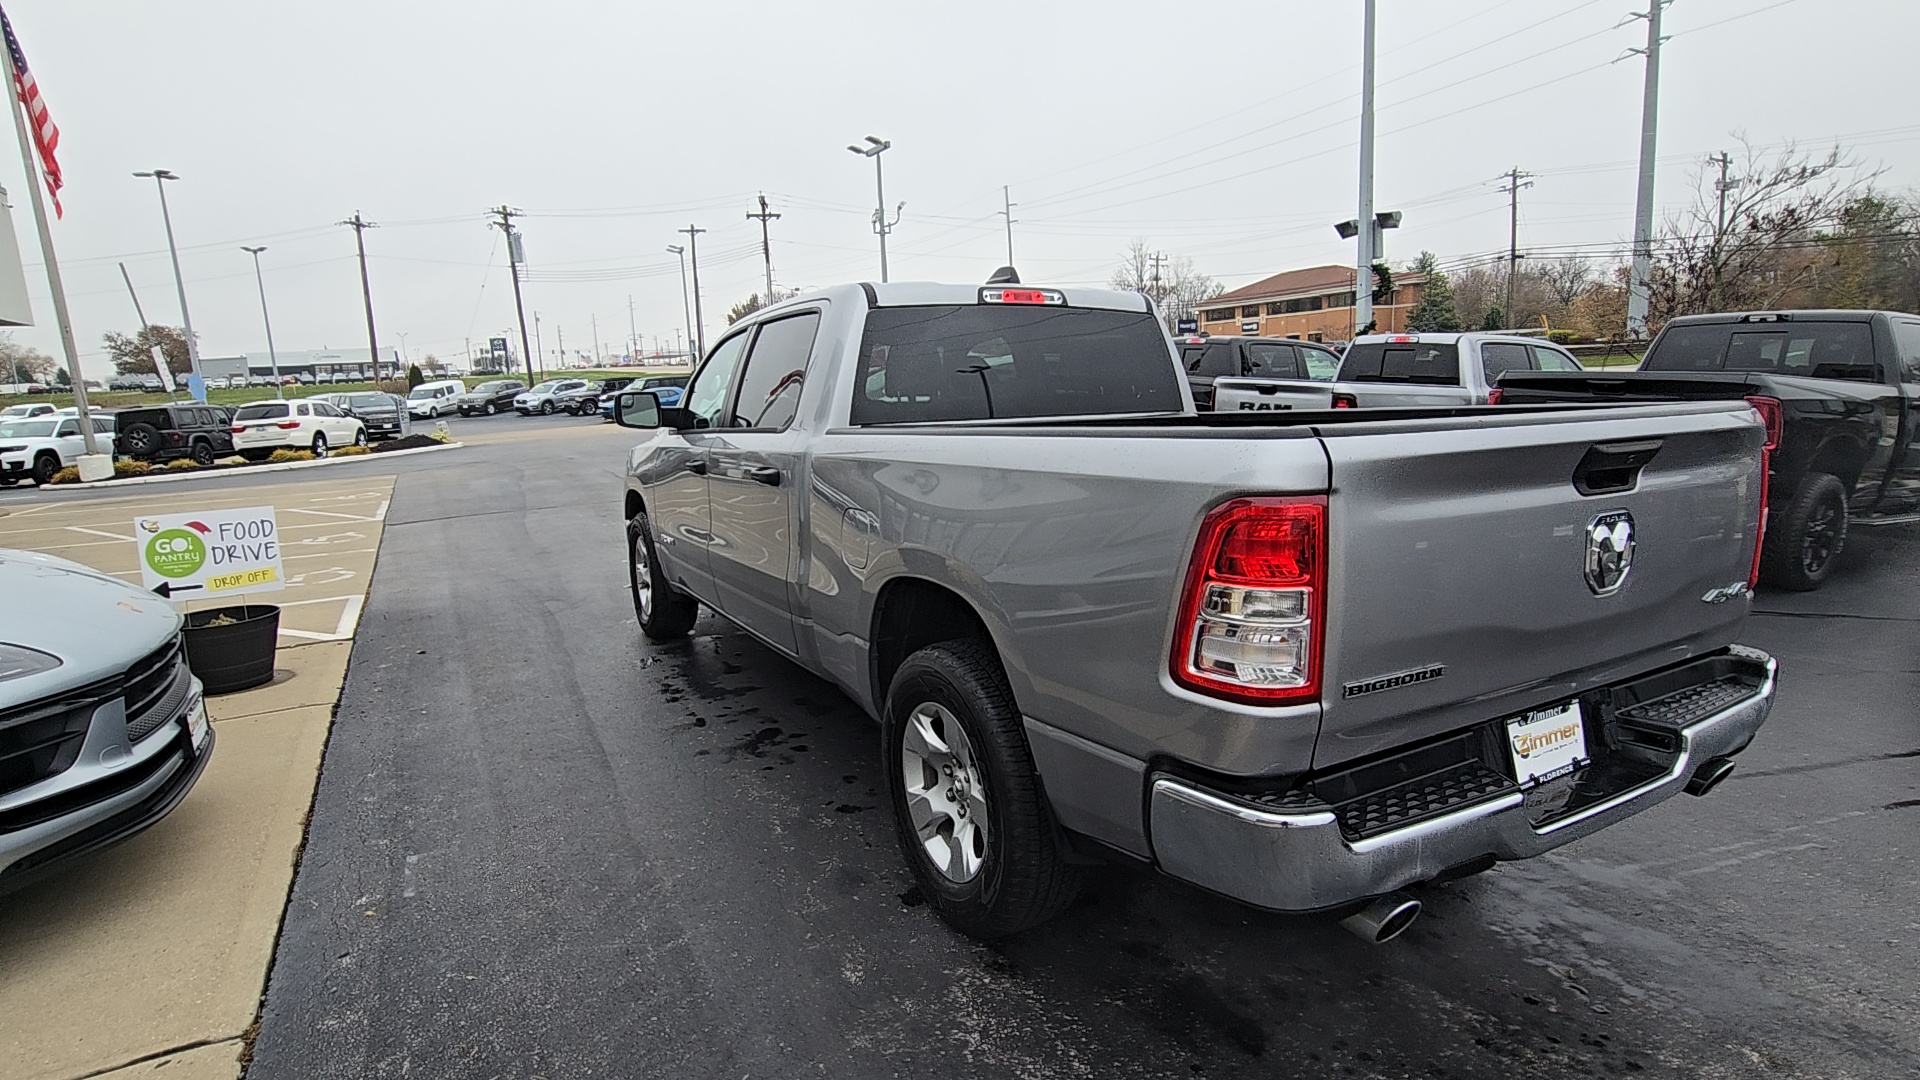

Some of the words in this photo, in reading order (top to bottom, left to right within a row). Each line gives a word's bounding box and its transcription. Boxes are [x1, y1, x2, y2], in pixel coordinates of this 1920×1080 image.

[1239, 402, 1292, 411] RAM
[219, 519, 274, 542] FOOD
[155, 537, 194, 554] GO!
[211, 541, 278, 565] DRIVE
[154, 551, 200, 563] PANTRY
[213, 574, 243, 588] DROP
[247, 569, 270, 583] OFF
[1346, 667, 1445, 697] BIGHORN
[1526, 705, 1564, 724] Zimmer
[1516, 723, 1580, 754] Zimmer
[1539, 764, 1575, 784] FLORENCE
